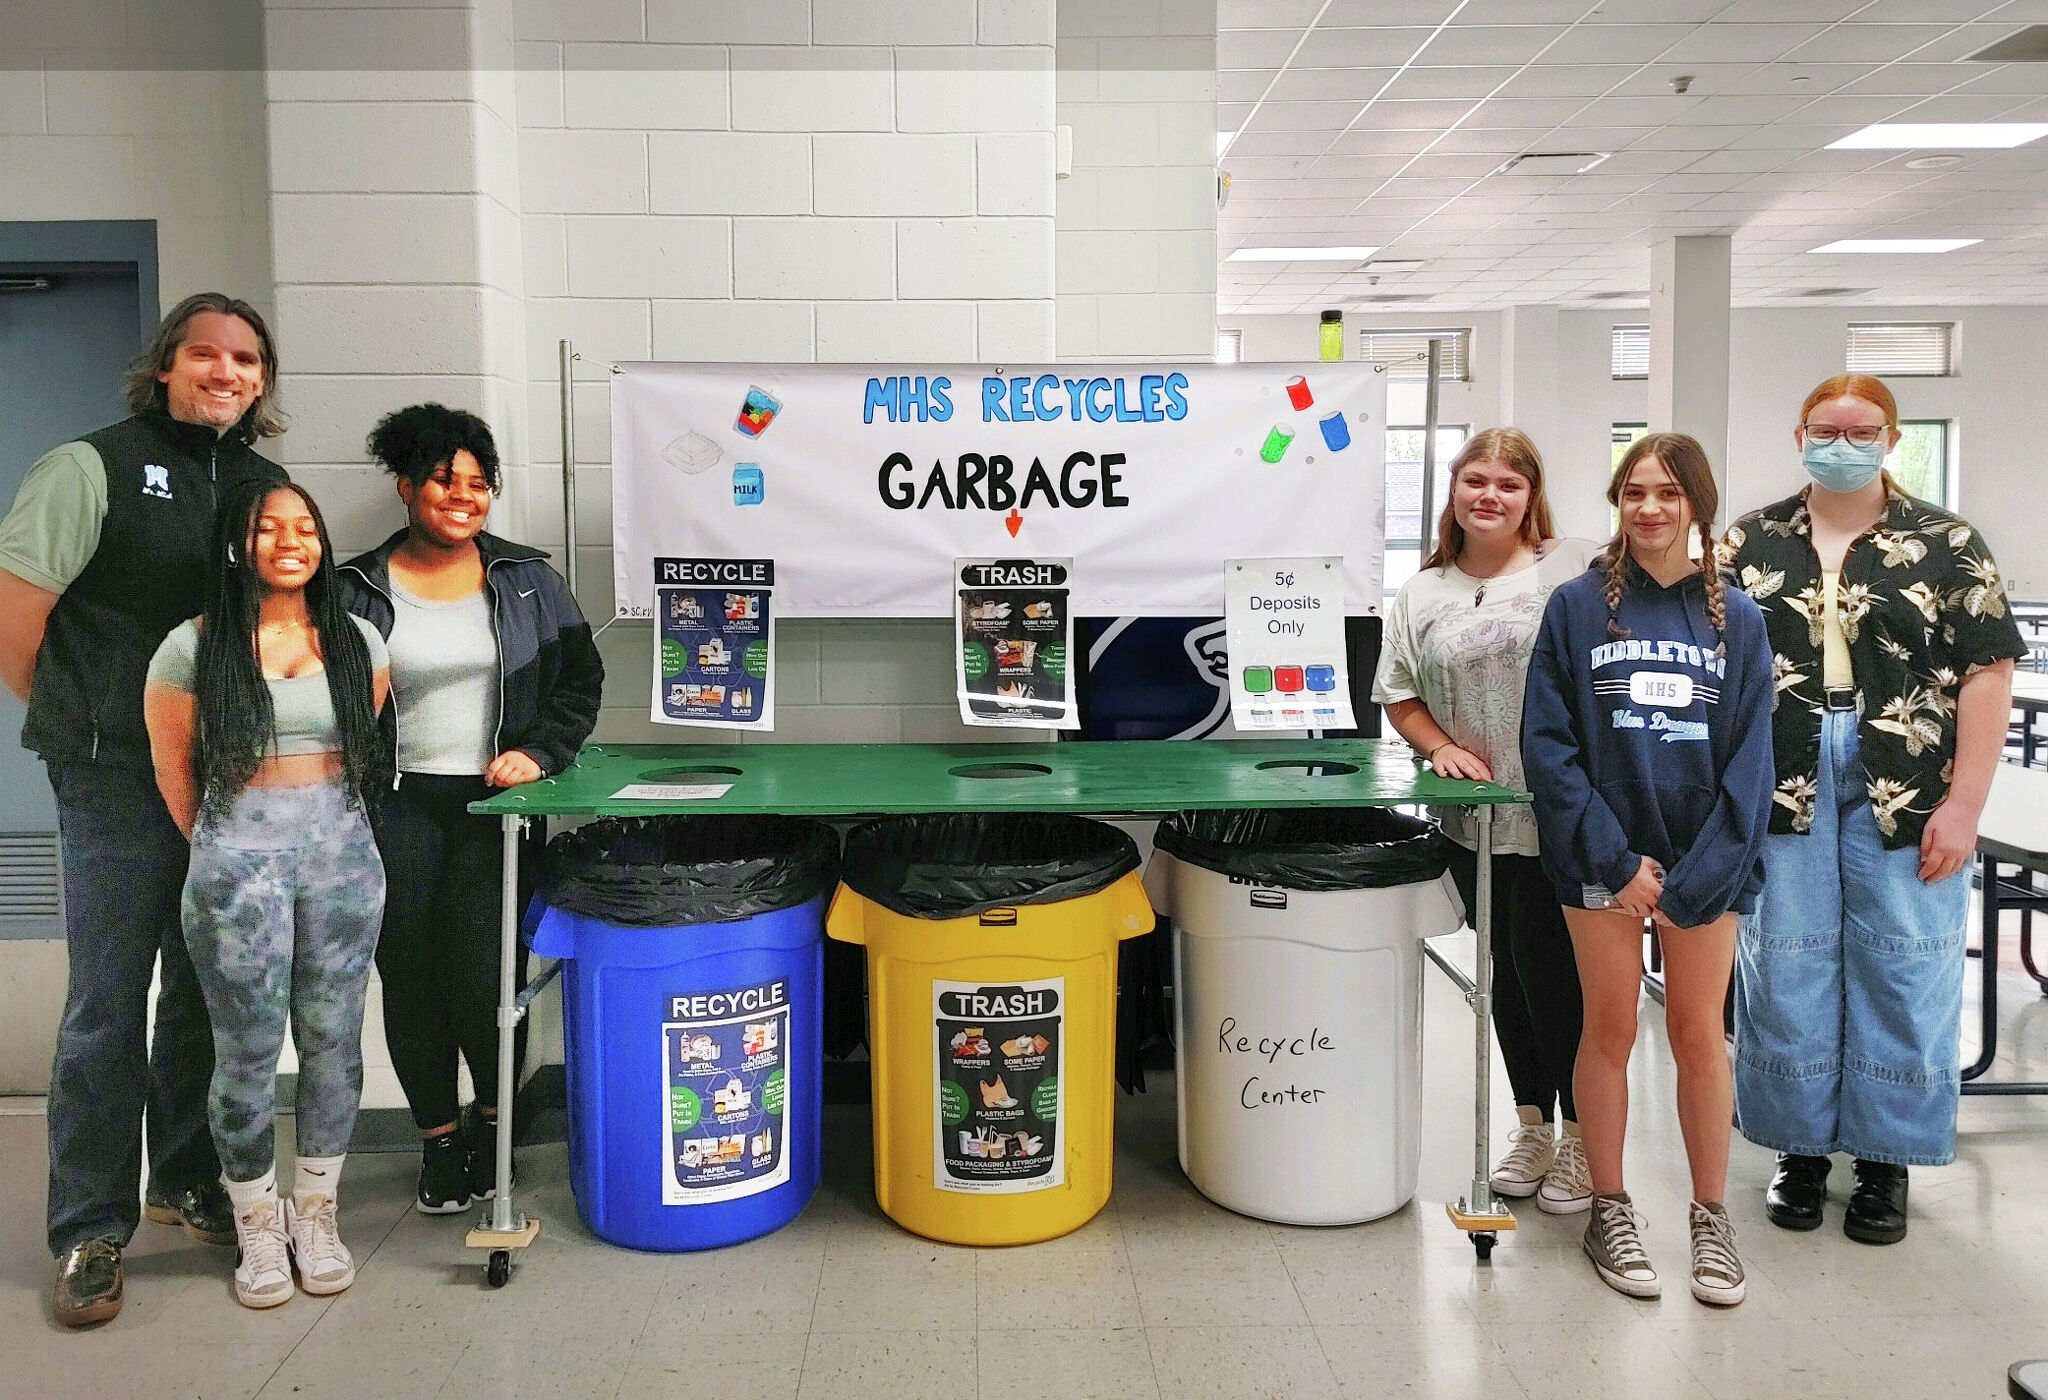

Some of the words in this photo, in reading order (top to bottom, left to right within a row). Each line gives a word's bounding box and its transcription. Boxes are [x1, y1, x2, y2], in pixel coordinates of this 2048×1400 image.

[863, 376, 954, 424] MHS
[982, 372, 1189, 423] RECYCLES
[878, 451, 1129, 511] GARBAGE
[734, 485, 757, 494] MILK
[663, 562, 766, 581] RECYCLE
[976, 566, 1052, 584] TRASH
[1275, 572, 1295, 588] 5¢
[1250, 596, 1321, 613] Deposits
[1267, 619, 1305, 637] Only
[1645, 681, 1677, 698] MHS
[1612, 709, 1645, 728] Blue
[672, 982, 784, 1018] RECYCLE
[955, 993, 1043, 1016] TRASH
[1219, 1017, 1336, 1063] Recycle
[741, 1054, 779, 1070] CONTAINERS
[748, 1051, 773, 1060] PLASTIC
[952, 1058, 991, 1067] WRAPPERS
[1004, 1058, 1023, 1066] SOME
[1024, 1056, 1046, 1064] PAPER
[690, 1062, 715, 1070] METAL
[1241, 1076, 1326, 1109] Center
[717, 1110, 749, 1122] CARTONS
[976, 1110, 1004, 1118] PLASTIC
[751, 1154, 772, 1165] GLASS
[965, 1160, 1004, 1168] PACKAGING
[702, 1166, 726, 1174] PAPER
